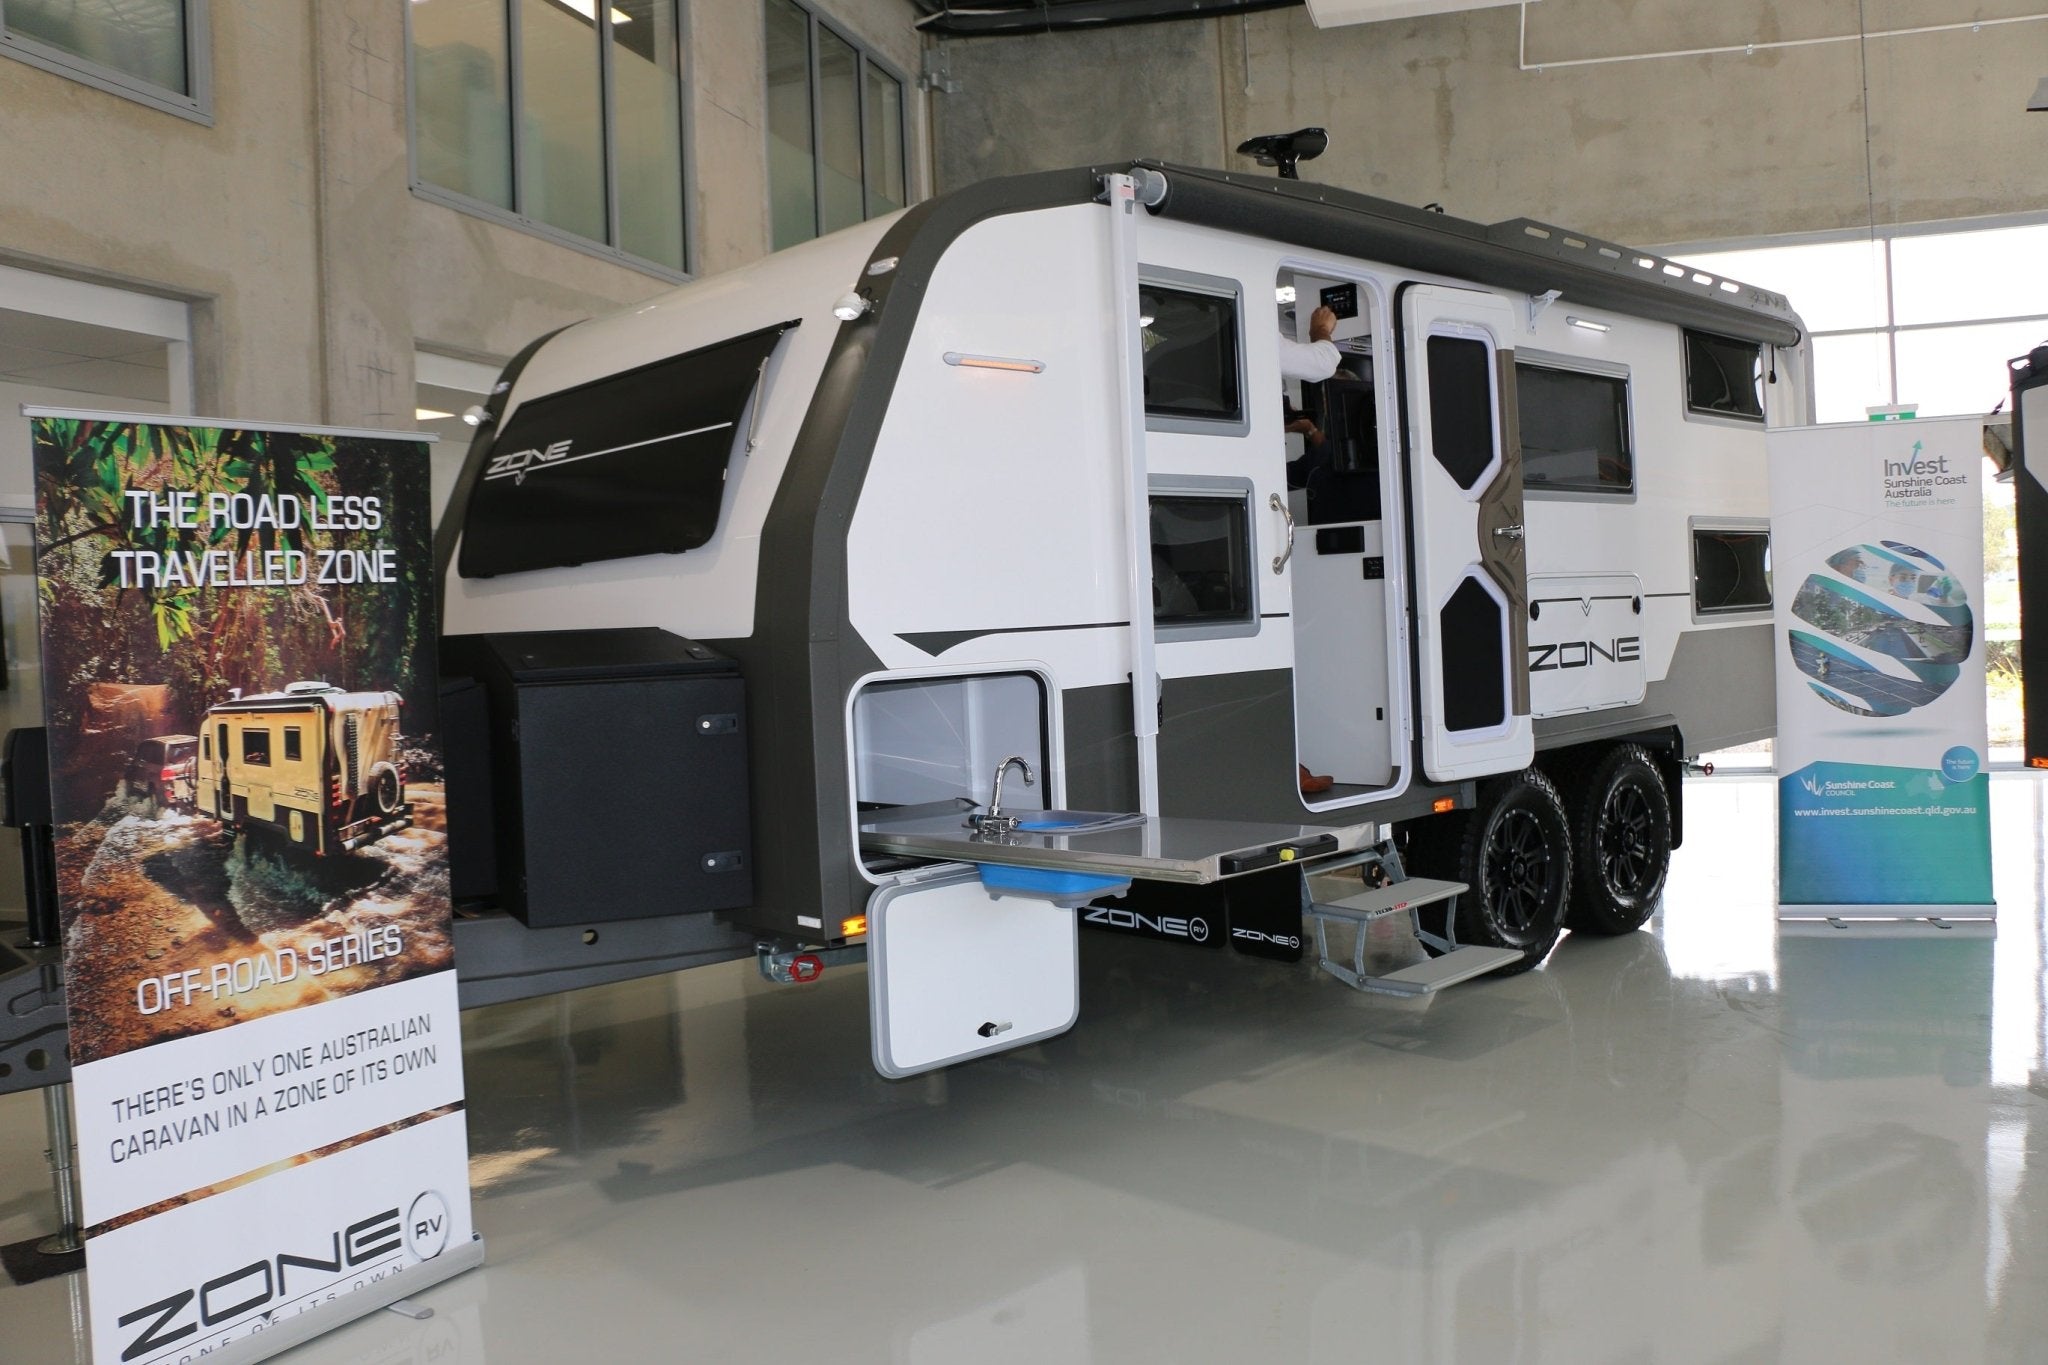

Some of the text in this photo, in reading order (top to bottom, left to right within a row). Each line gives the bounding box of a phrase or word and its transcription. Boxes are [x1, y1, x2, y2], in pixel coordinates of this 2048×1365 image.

[487, 439, 573, 474] ZONE
[1884, 454, 1949, 477] Invest
[1884, 474, 1967, 489] Sunshine Coast
[1884, 487, 1932, 499] Australia
[125, 491, 382, 530] THE ROAD LESS
[1886, 500, 1901, 508] The
[1901, 499, 1927, 508] future
[1936, 498, 1955, 506] here
[111, 549, 397, 589] TRAVELLED ZONE
[1528, 636, 1640, 672] ZONE
[1825, 780, 1896, 790] Sunshine Coast
[1825, 789, 1856, 797] COUNCIL
[1794, 804, 1977, 818] www.invest.sunshinecoast.qld.gov.au
[1084, 906, 1205, 937] ZONE RV
[1232, 928, 1290, 946] ZONE
[137, 924, 402, 1016] OFF-ROAD SERIES
[112, 1013, 432, 1124] THERE'S ONLY ONE AUSTRALIAN
[110, 1044, 437, 1164] CARAVAN IN A ZONE OF ITS OWN
[118, 1207, 443, 1363] ZONE RV
[300, 1292, 336, 1315] ITS
[353, 1263, 404, 1291] OWN
